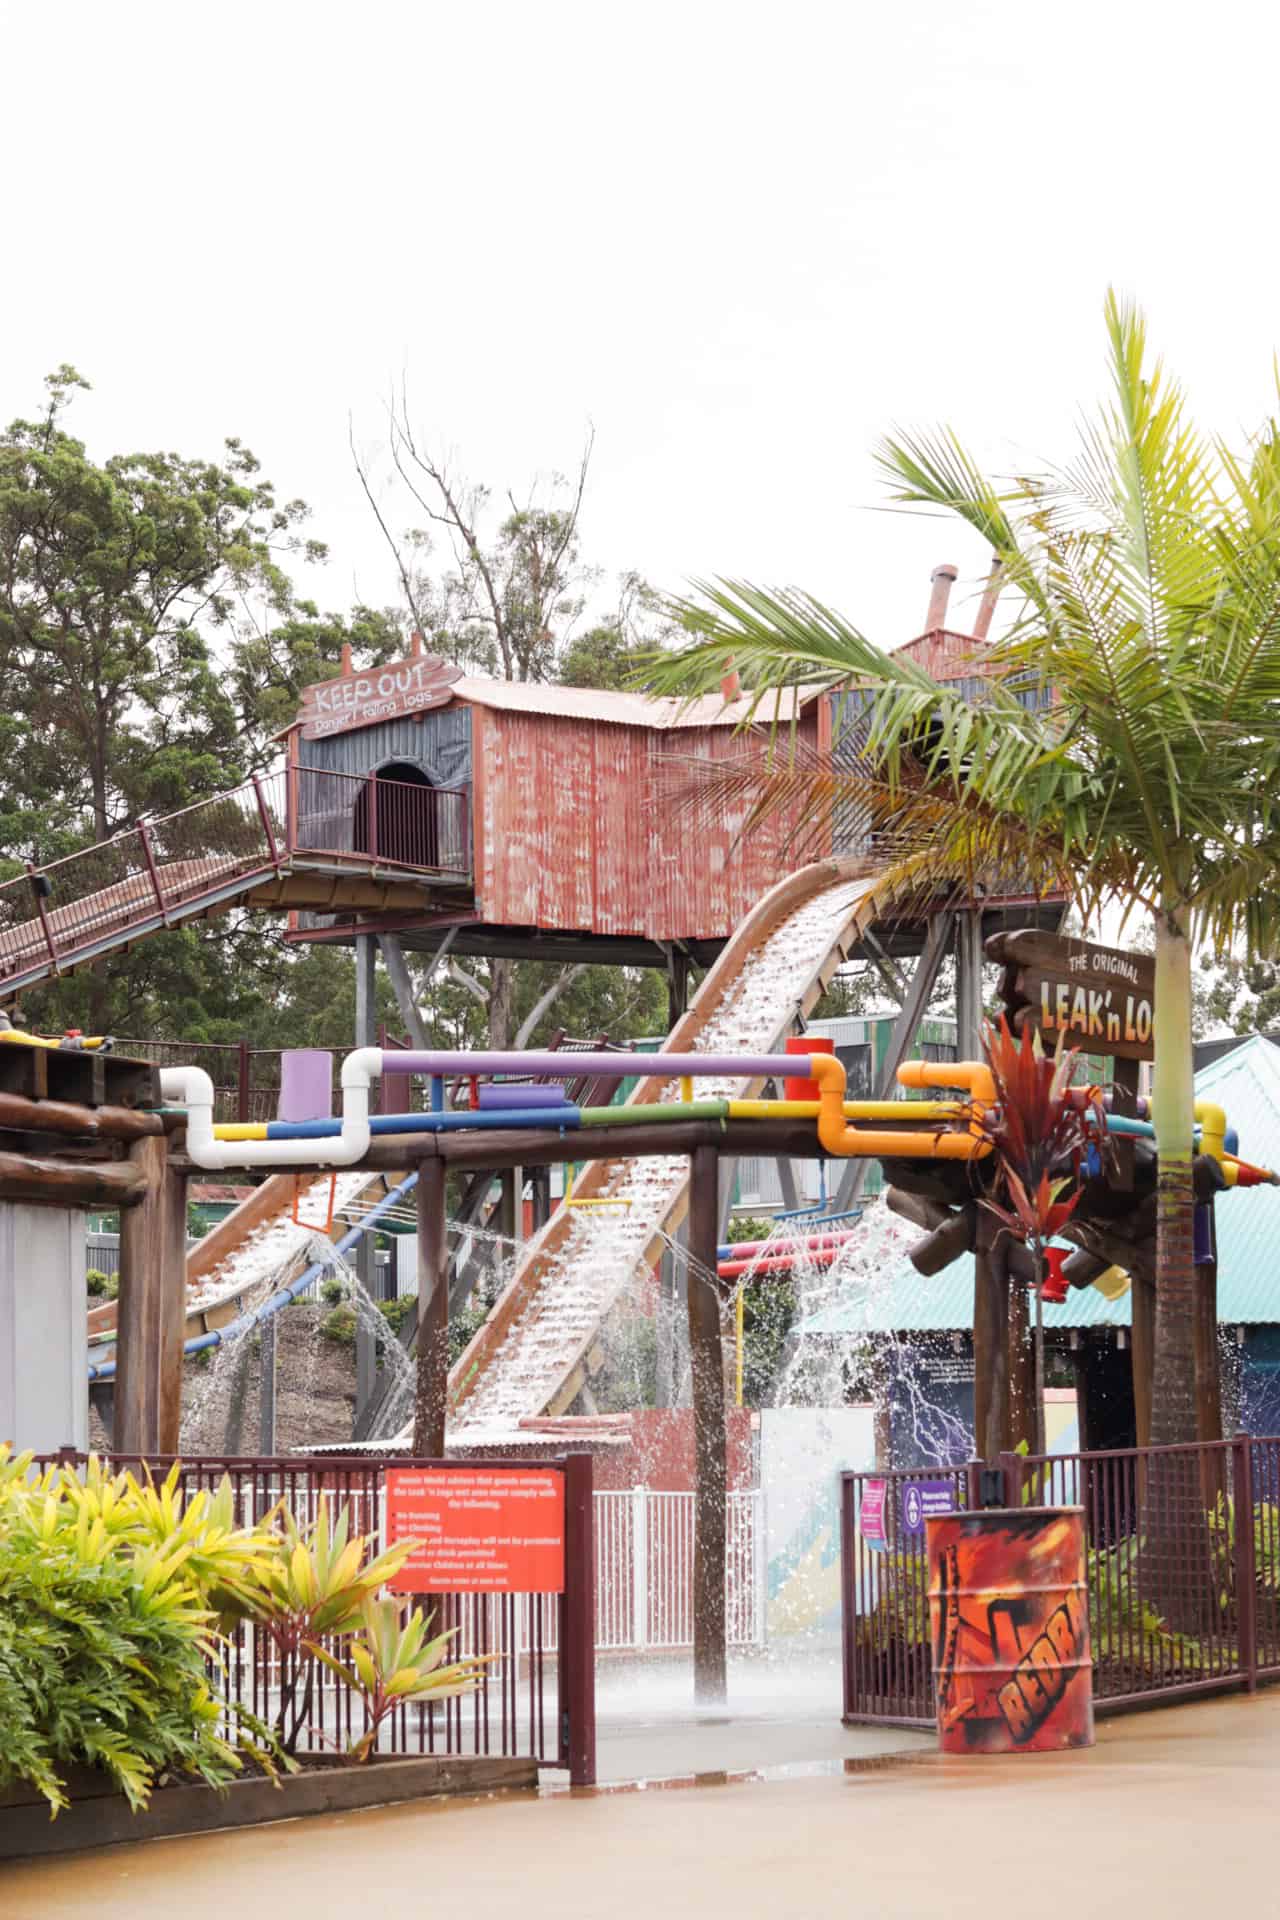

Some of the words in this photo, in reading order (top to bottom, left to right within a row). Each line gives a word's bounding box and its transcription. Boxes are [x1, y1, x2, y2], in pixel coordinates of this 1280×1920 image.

[315, 680, 371, 712] KEEP
[377, 662, 425, 697] OUT
[402, 690, 433, 709] logs
[1069, 954, 1088, 972] THE
[1092, 953, 1139, 985] ORIGINAL
[1125, 995, 1156, 1044] LO
